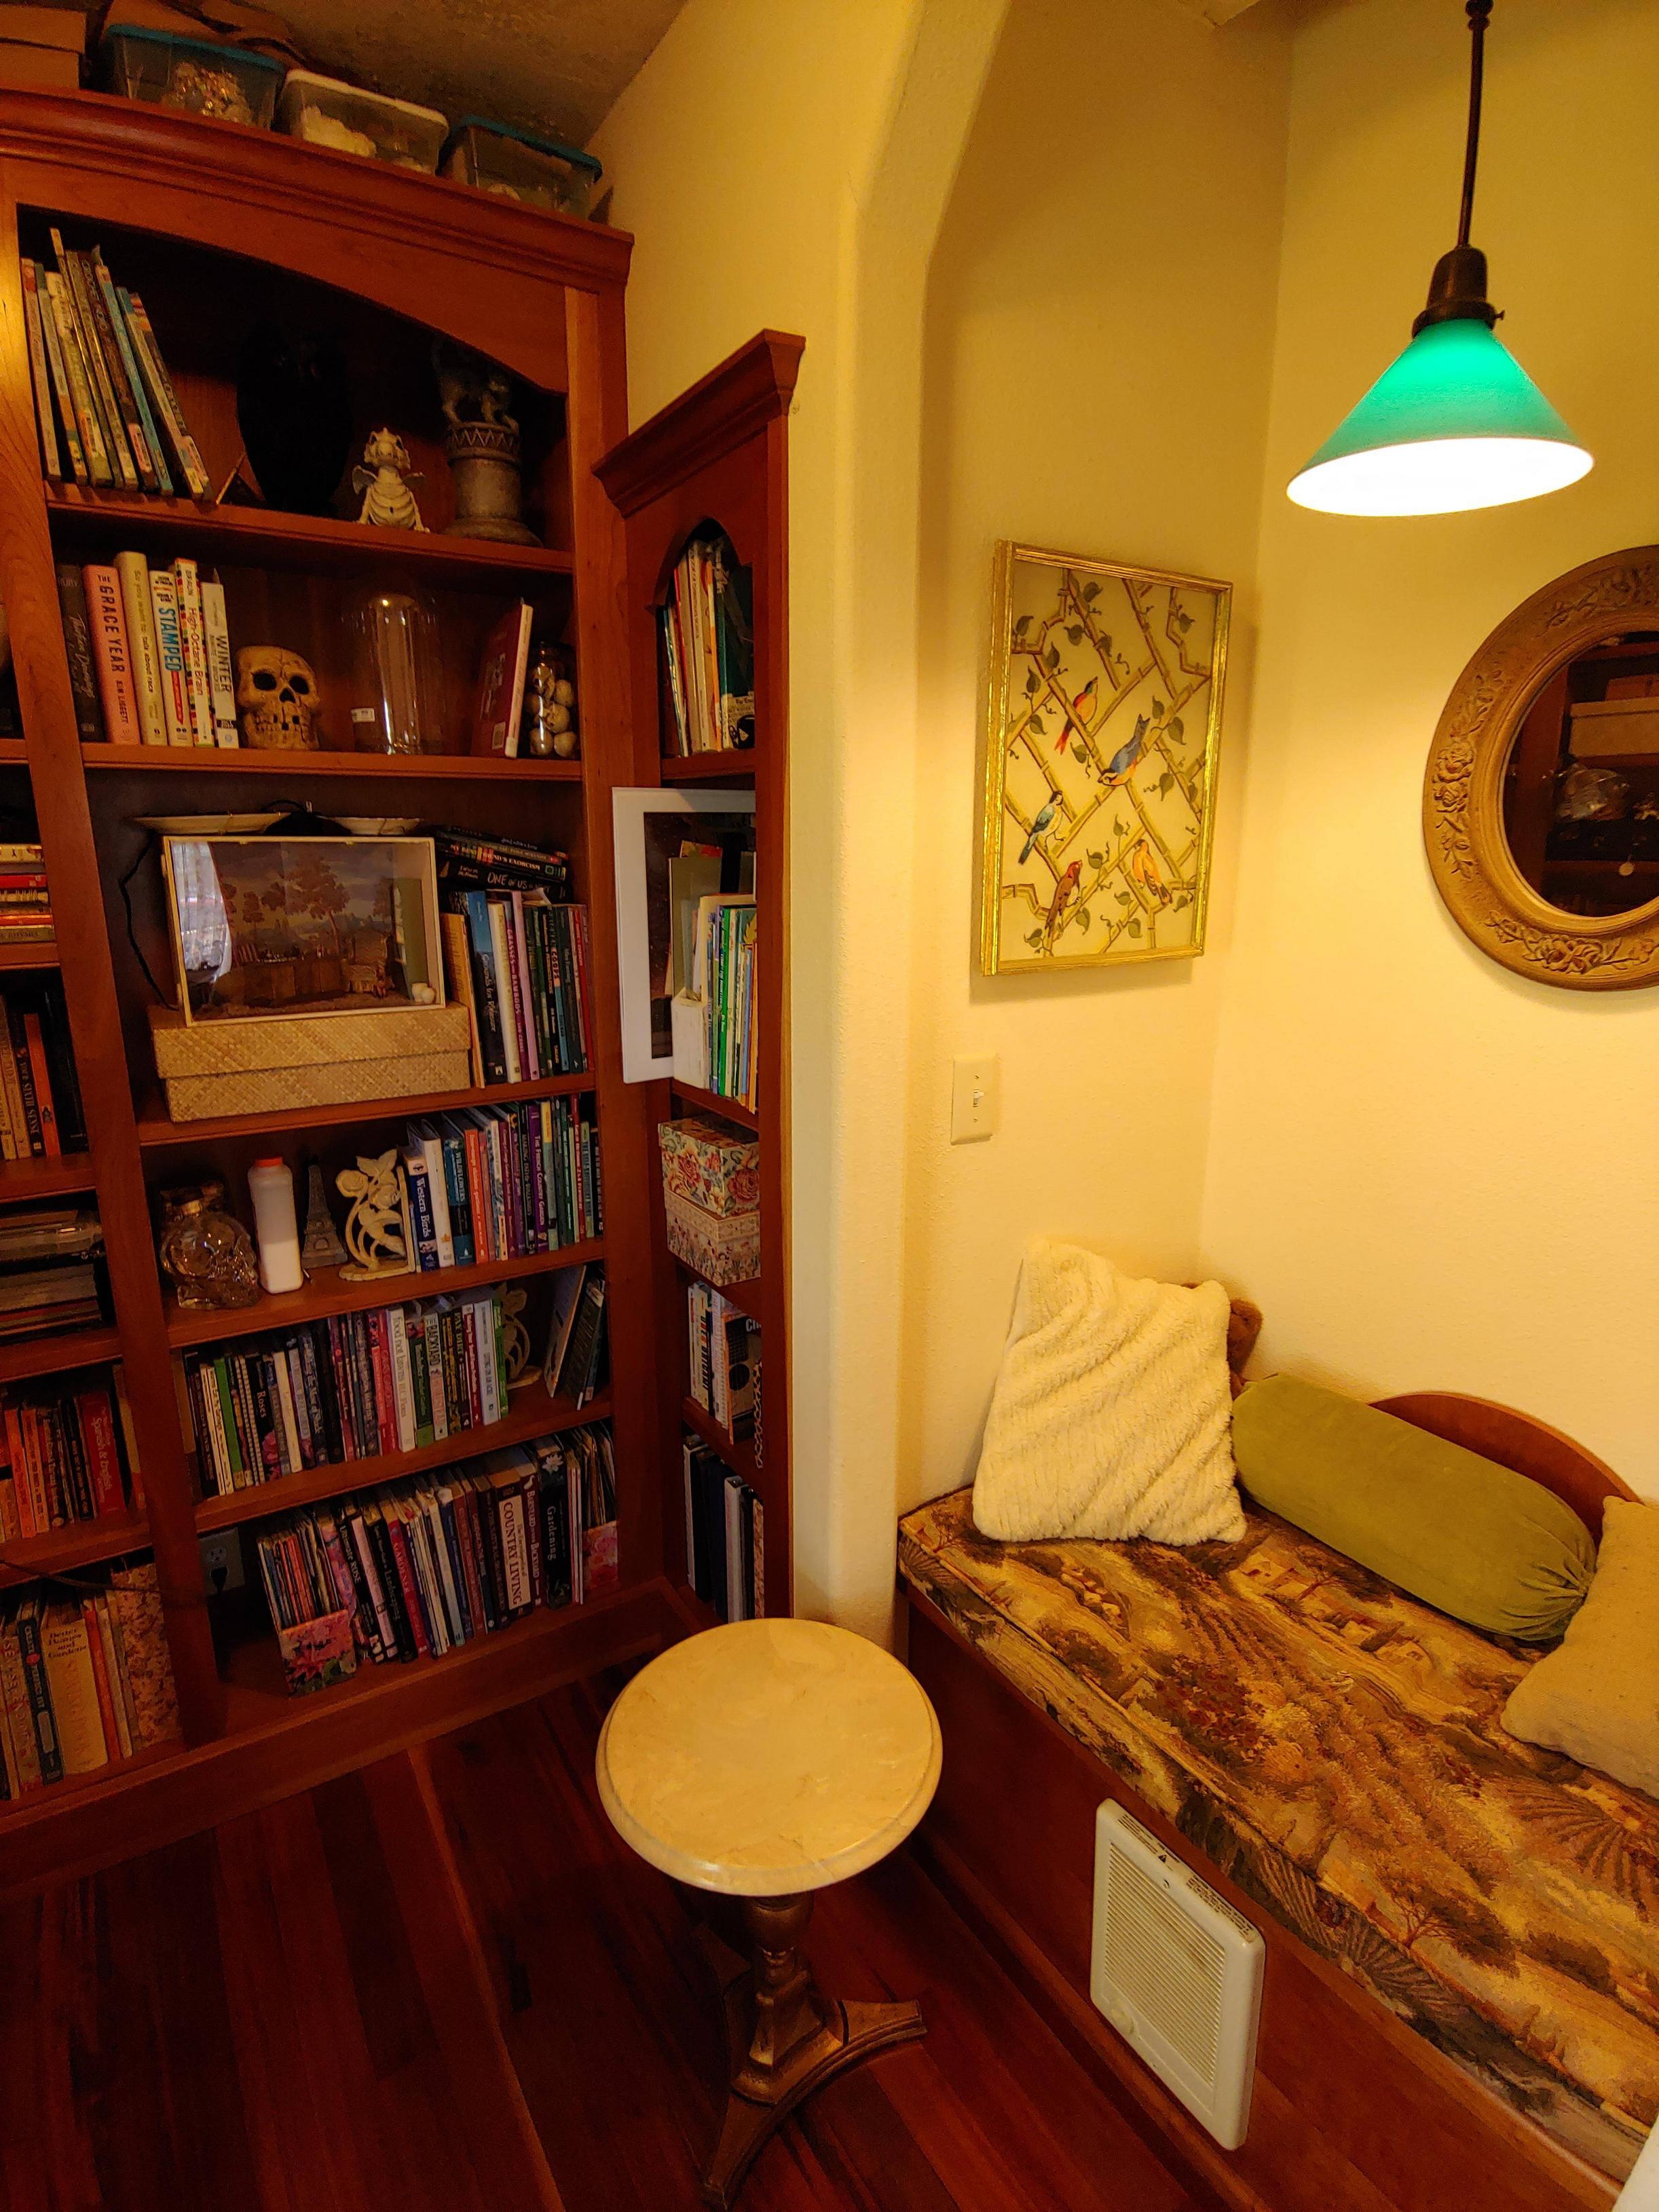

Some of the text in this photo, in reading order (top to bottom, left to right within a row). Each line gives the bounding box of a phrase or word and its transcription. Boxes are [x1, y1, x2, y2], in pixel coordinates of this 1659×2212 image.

[100, 584, 124, 673] GRACE YEAR
[159, 606, 181, 673] STAMPED
[187, 607, 205, 695] High-Octane Brain
[217, 634, 231, 693] WINTER
[487, 871, 508, 884] ONE
[517, 880, 527, 889] US
[510, 859, 540, 870] EXORCISM
[506, 929, 515, 963] GRASSES
[512, 975, 521, 1013] BAMBOOS
[482, 954, 497, 1032] Grounds for Pleasure
[22, 1083, 34, 1106] SIXTH
[26, 1109, 39, 1133] SENSE
[456, 1152, 464, 1201] WILDFLOWERS
[536, 1172, 544, 1199] COUNTRY
[416, 1178, 431, 1237] Western Birds
[393, 1317, 403, 1336] food
[455, 1332, 464, 1355] DIRT
[395, 1340, 403, 1352] not
[427, 1326, 439, 1365] BACKYARD
[396, 1355, 406, 1380] lawns
[257, 1391, 266, 1417] Roses
[90, 1417, 112, 1490] Spanish & English
[527, 1490, 536, 1526] BARNYARD
[547, 1506, 556, 1560] Gardening
[503, 1502, 521, 1604] COUNTRY LIVING
[531, 1543, 540, 1578] BACKYARD
[350, 1561, 360, 1583] ROSE
